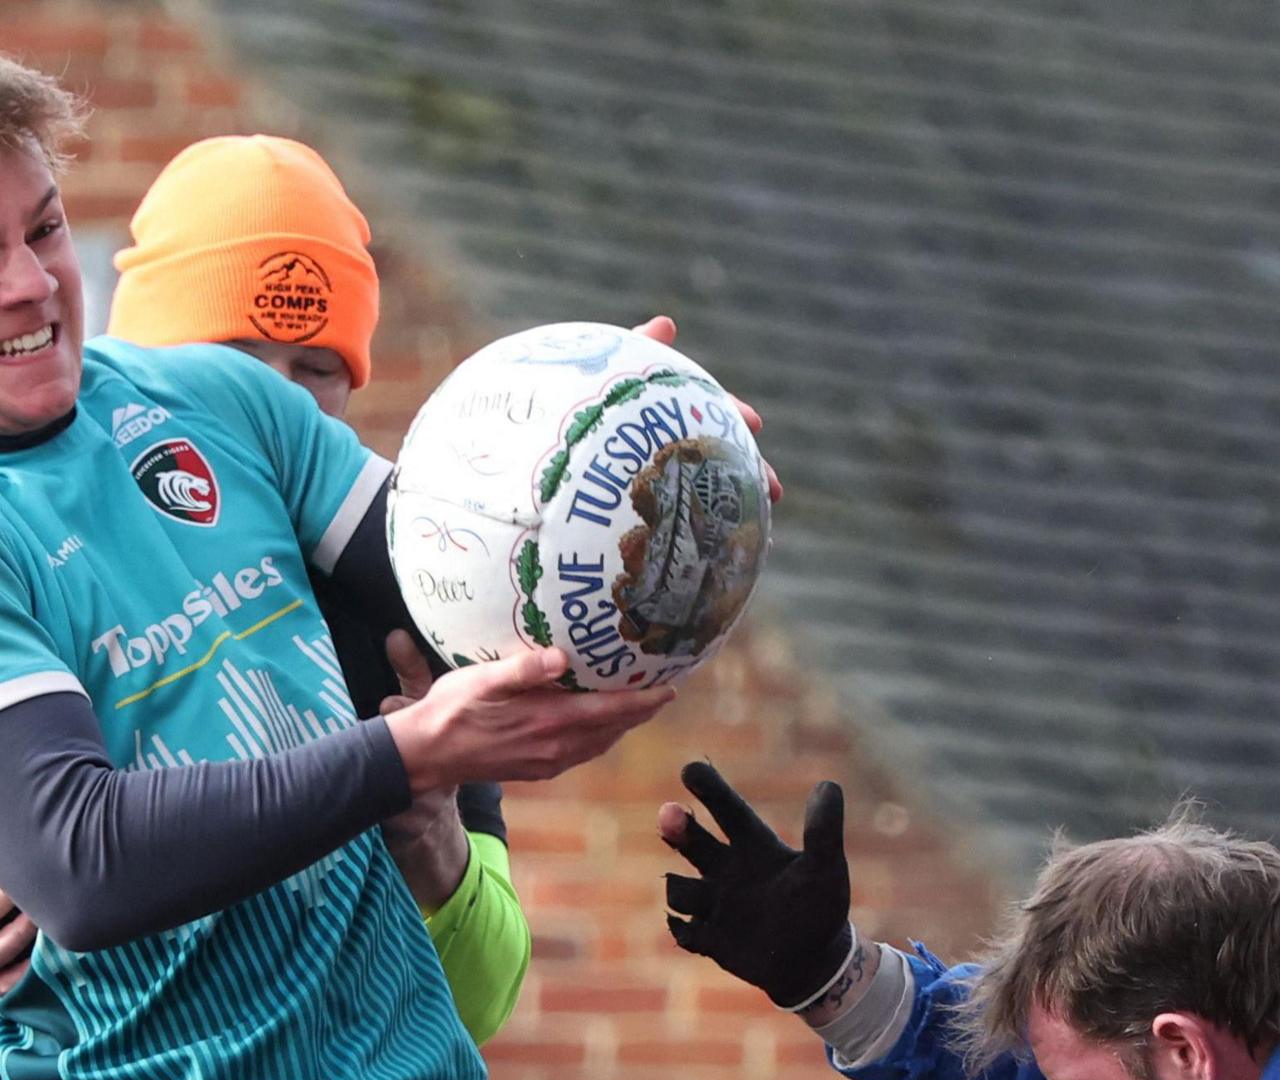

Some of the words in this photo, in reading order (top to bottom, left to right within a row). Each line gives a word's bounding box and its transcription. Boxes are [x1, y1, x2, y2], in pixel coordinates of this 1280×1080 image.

[254, 294, 328, 313] COMPS
[567, 397, 688, 528] TUESDAY
[558, 551, 637, 679] SHROVE
